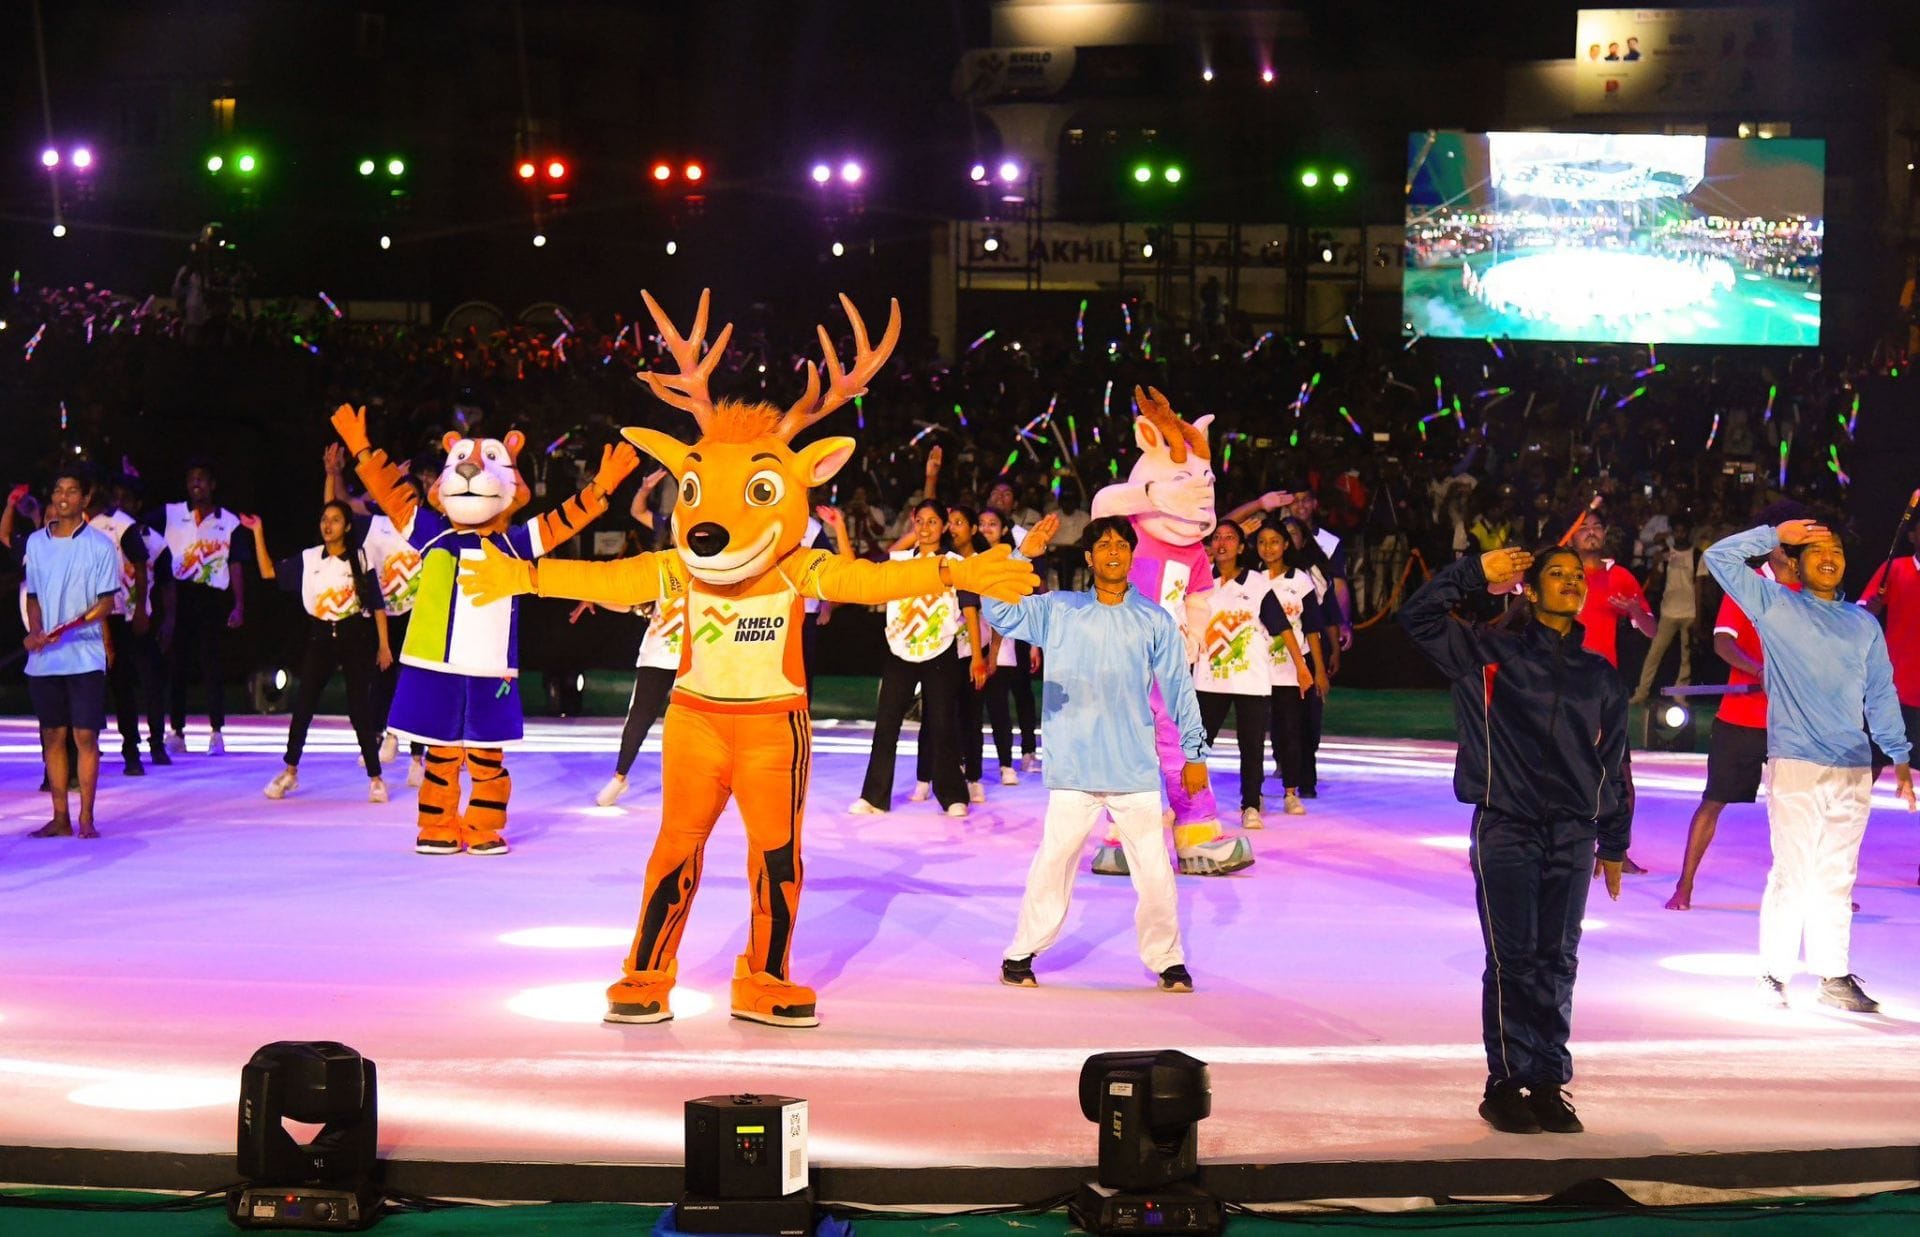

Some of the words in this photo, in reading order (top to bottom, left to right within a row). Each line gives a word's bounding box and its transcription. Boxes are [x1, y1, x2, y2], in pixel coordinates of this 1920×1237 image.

[1029, 240, 1179, 264] AKHILE
[737, 616, 784, 629] KHELO
[734, 630, 775, 642] INDIA
[1112, 1111, 1122, 1140] LBT
